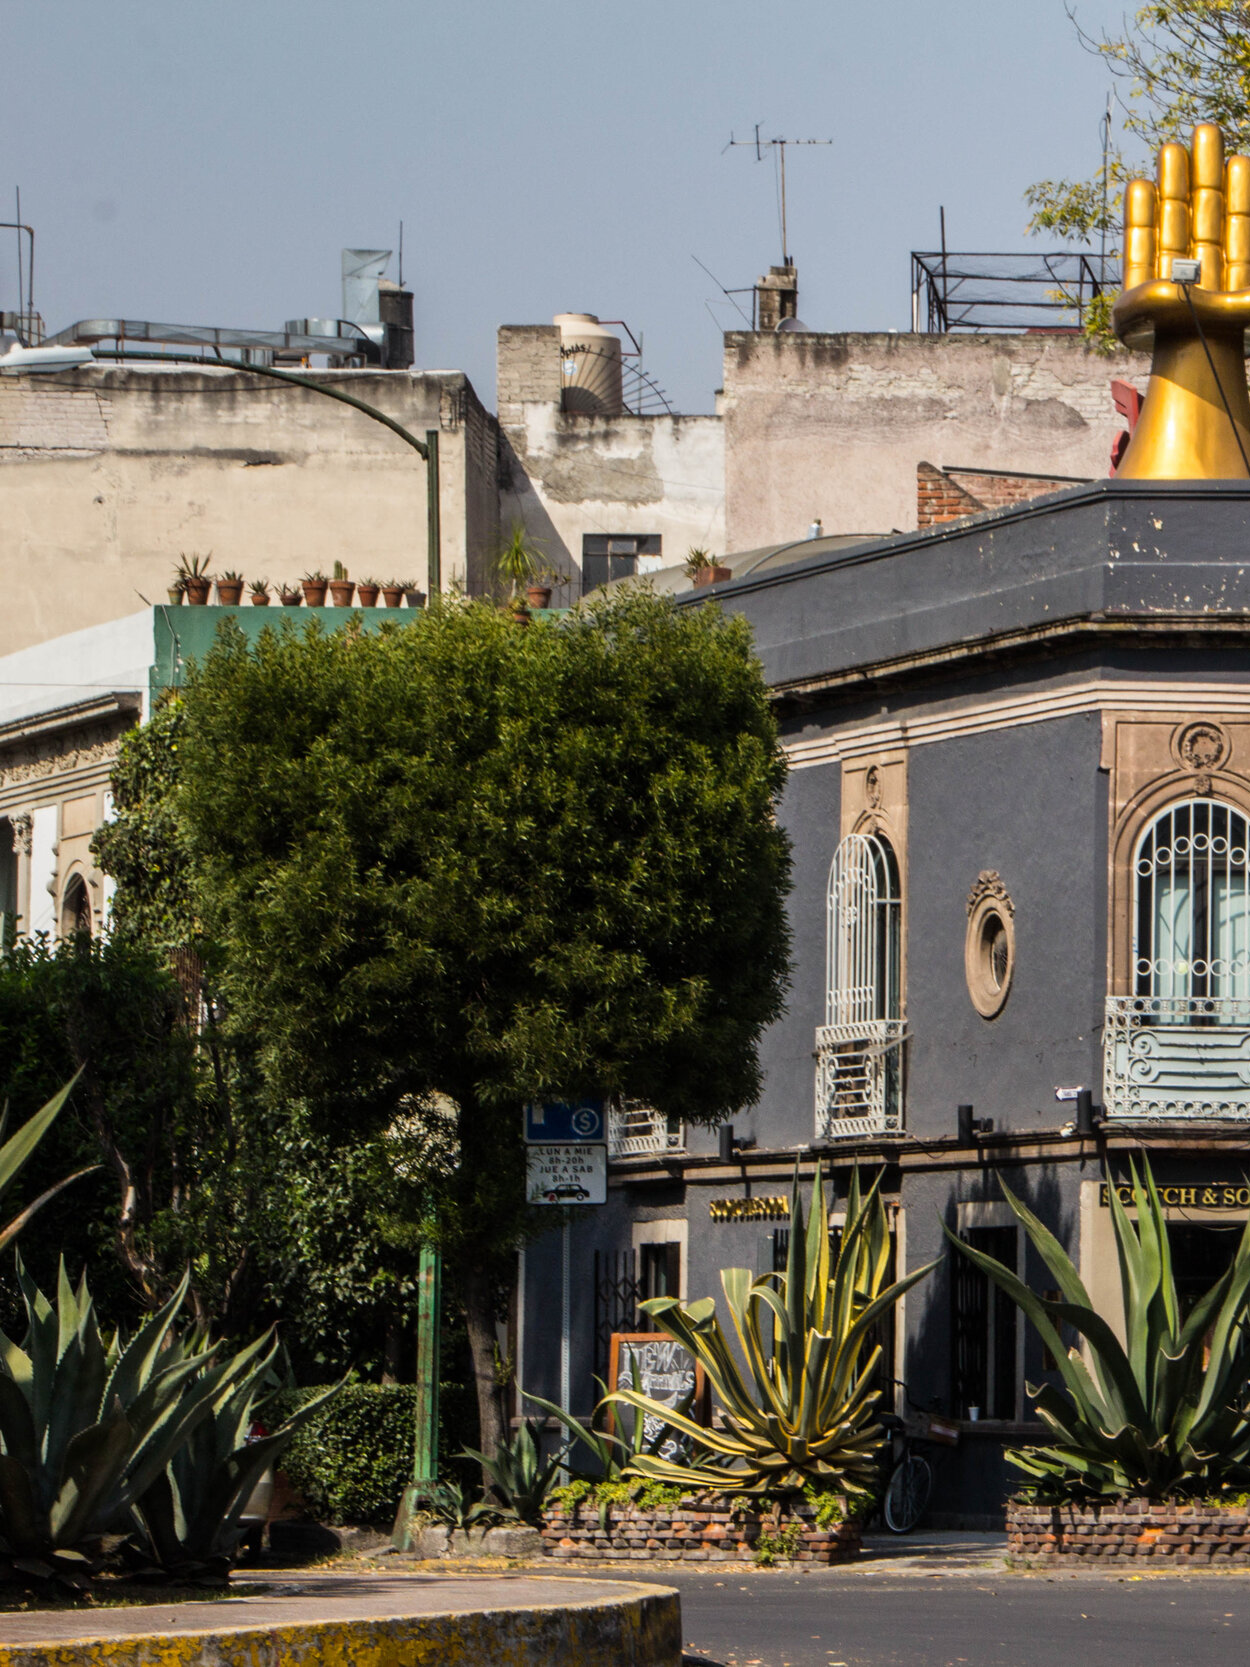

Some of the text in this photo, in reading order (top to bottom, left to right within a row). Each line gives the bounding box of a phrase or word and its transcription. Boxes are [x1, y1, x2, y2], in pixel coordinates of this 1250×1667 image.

[564, 1147, 571, 1156] A
[574, 1147, 593, 1156] MIE
[548, 1156, 585, 1165] 8h-20h
[539, 1165, 594, 1174] JUE A SAB
[552, 1174, 581, 1183] 8h-1h
[1102, 1187, 1197, 1205] SCOCH
[1202, 1188, 1218, 1205] &
